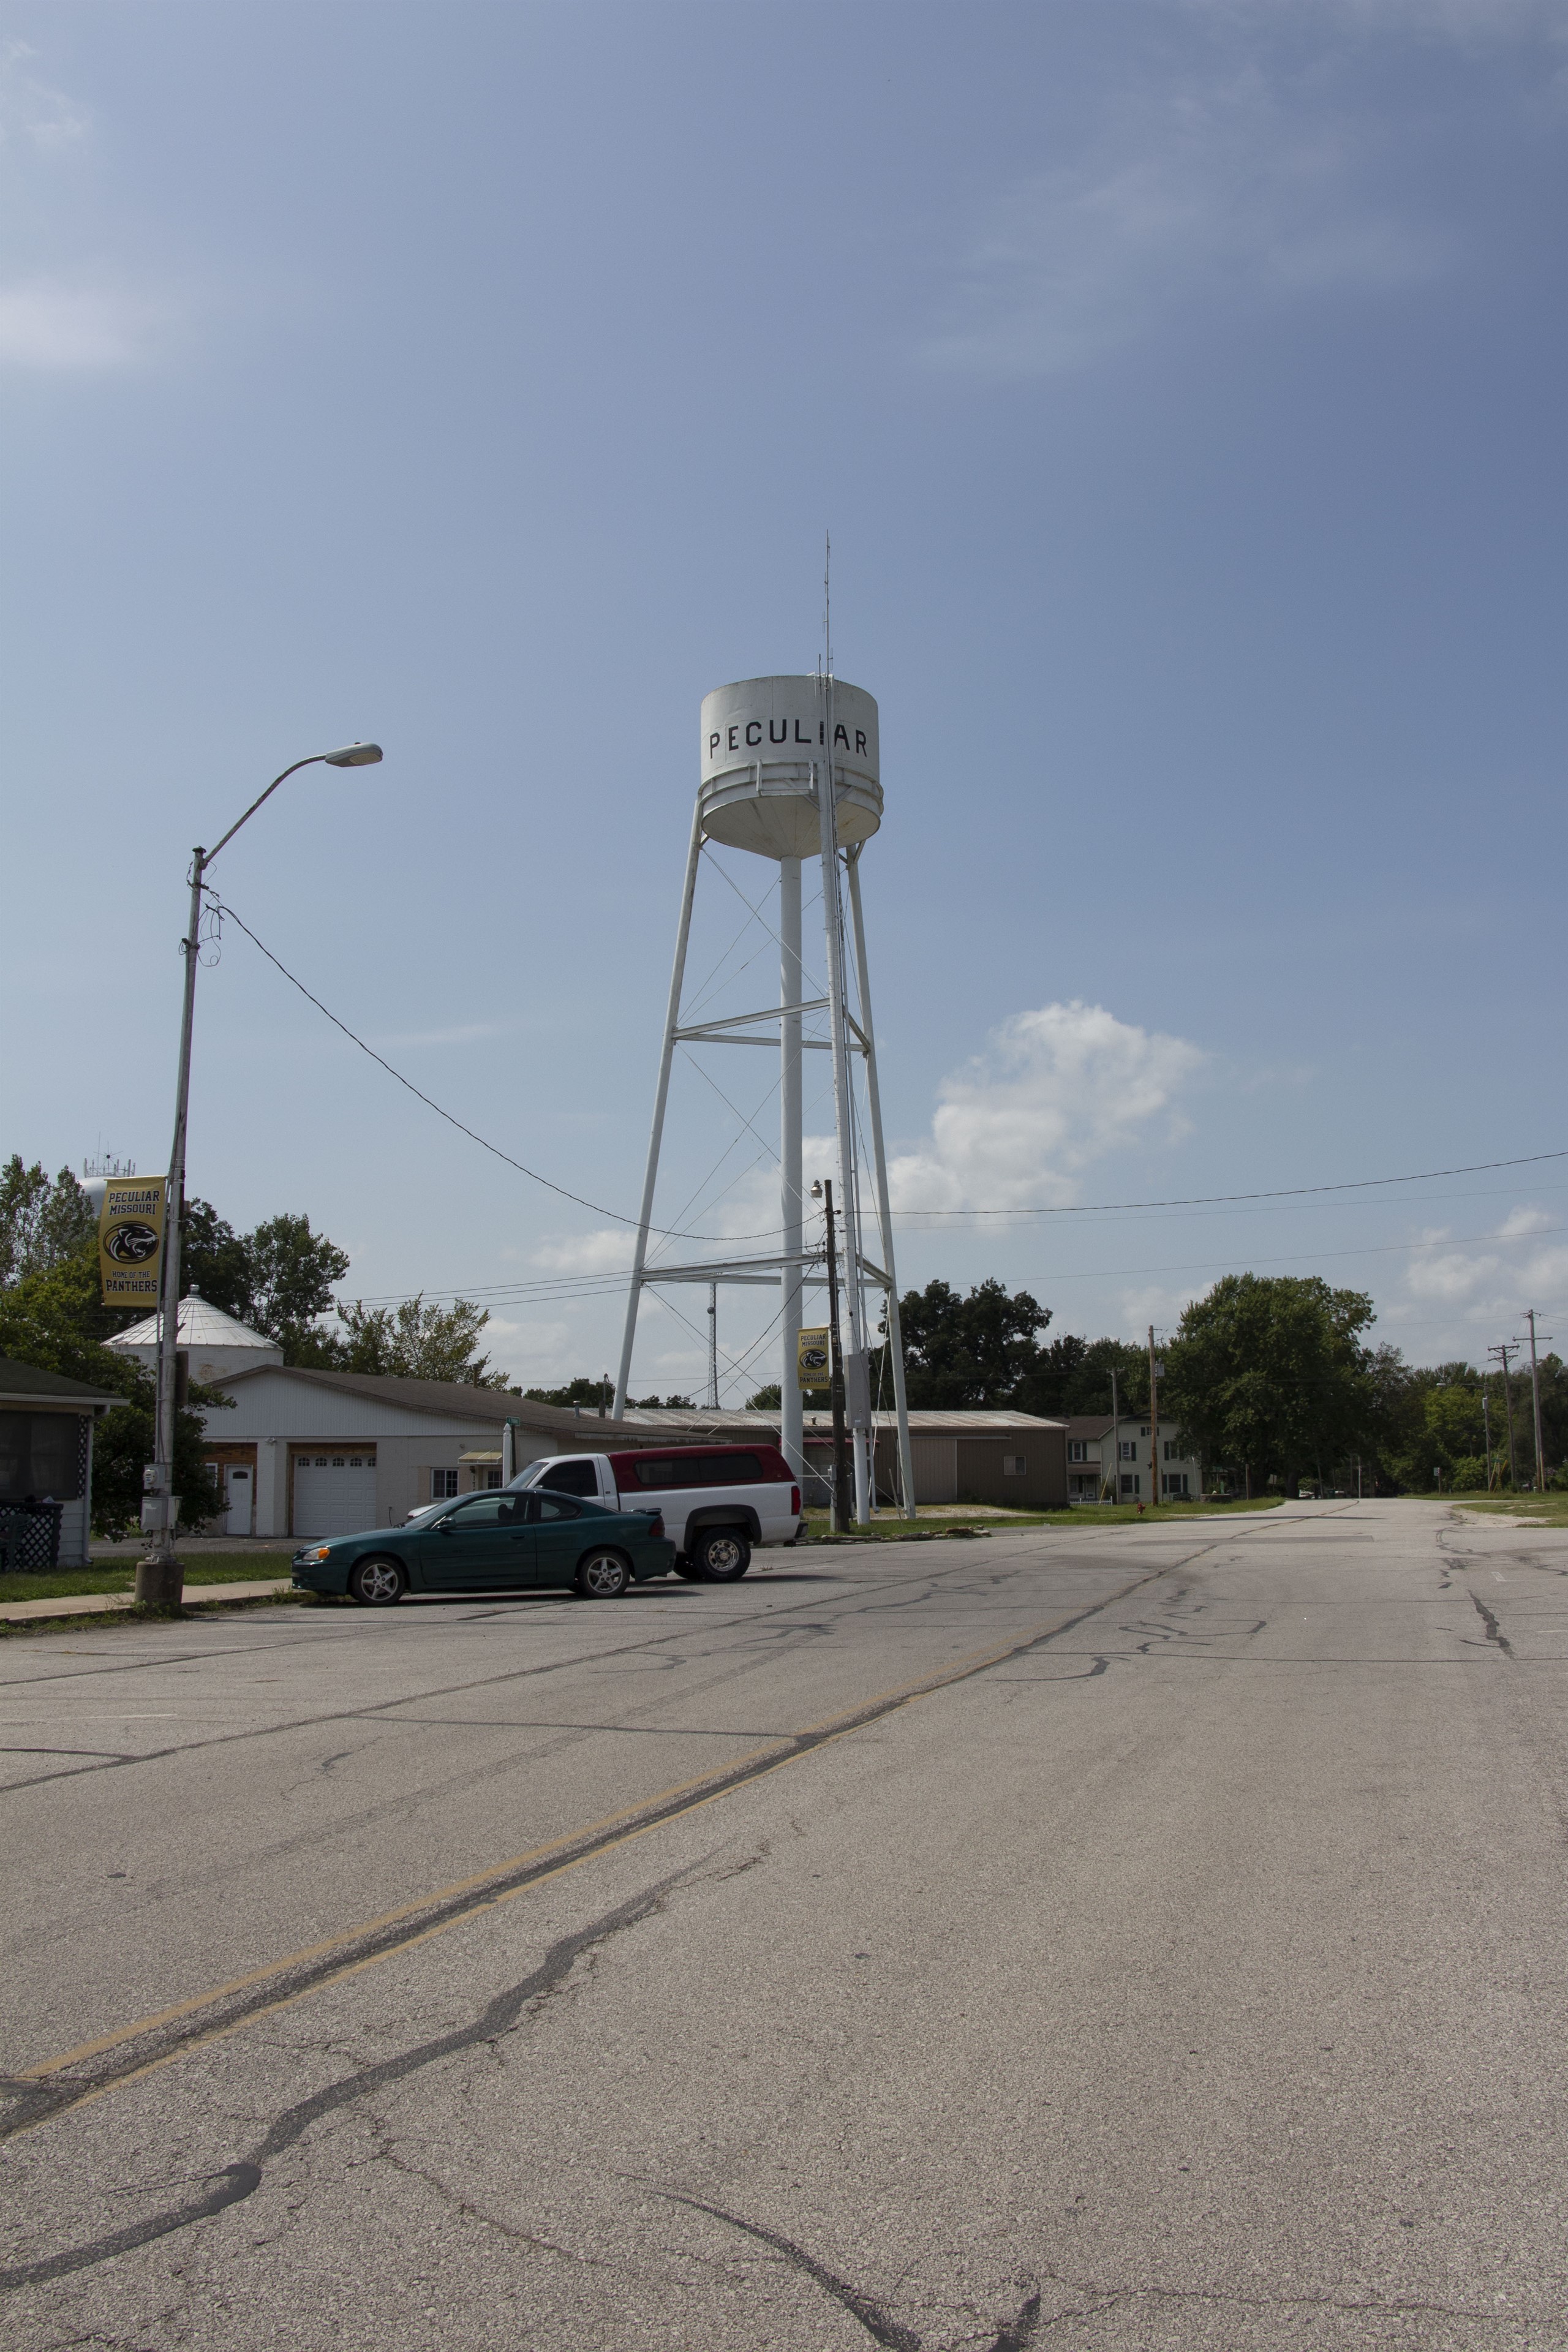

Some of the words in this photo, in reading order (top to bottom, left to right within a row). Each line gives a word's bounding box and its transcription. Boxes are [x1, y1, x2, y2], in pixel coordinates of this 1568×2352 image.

[710, 719, 867, 759] PECULIAR
[108, 1190, 160, 1203] PECULIAR
[109, 1204, 156, 1216] MISSOURI
[106, 1280, 157, 1292] PANTHERS
